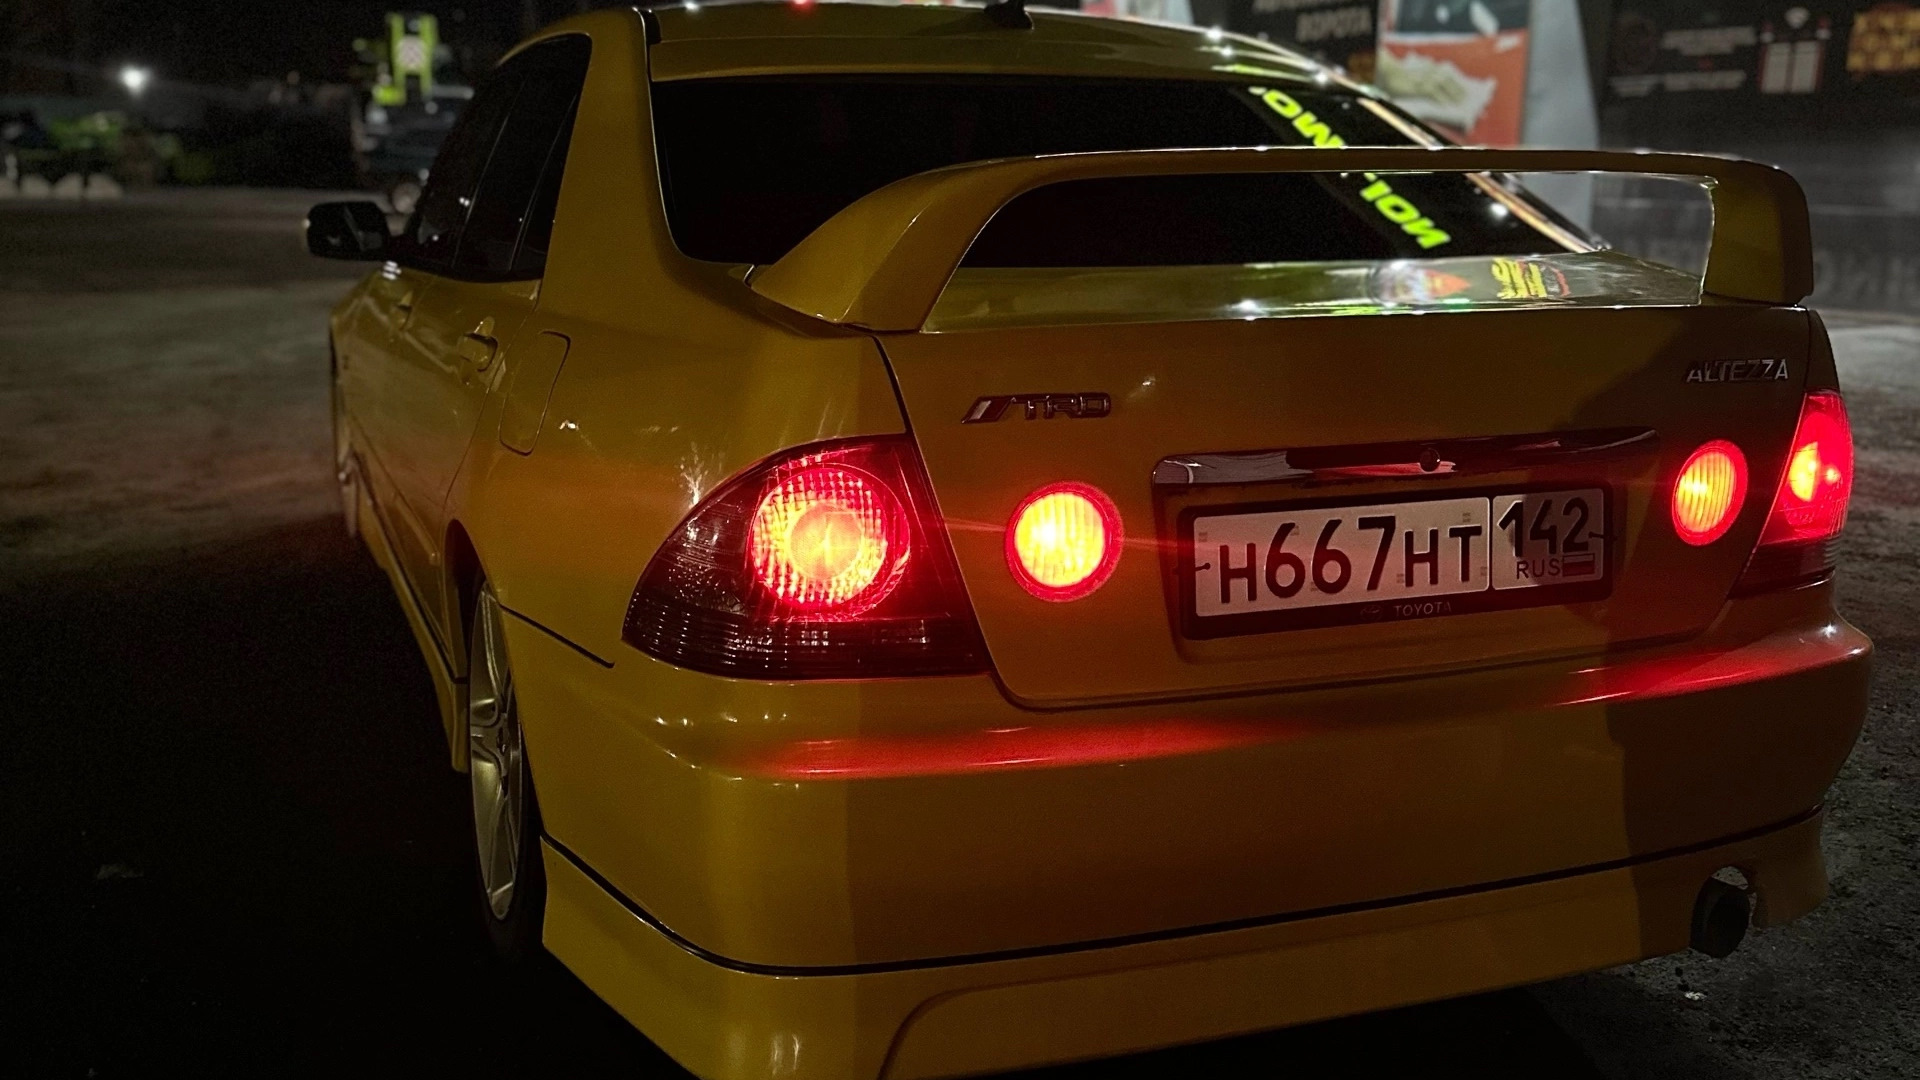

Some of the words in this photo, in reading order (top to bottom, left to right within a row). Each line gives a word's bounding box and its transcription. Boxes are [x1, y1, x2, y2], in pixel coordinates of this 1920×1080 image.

[1685, 358, 1789, 384] ALTEZZA
[1010, 393, 1111, 420] TRD
[1219, 515, 1482, 603] Н667НТ
[1498, 497, 1590, 557] 142
[1515, 557, 1561, 580] RUS
[1392, 600, 1453, 617] TOYOTA
